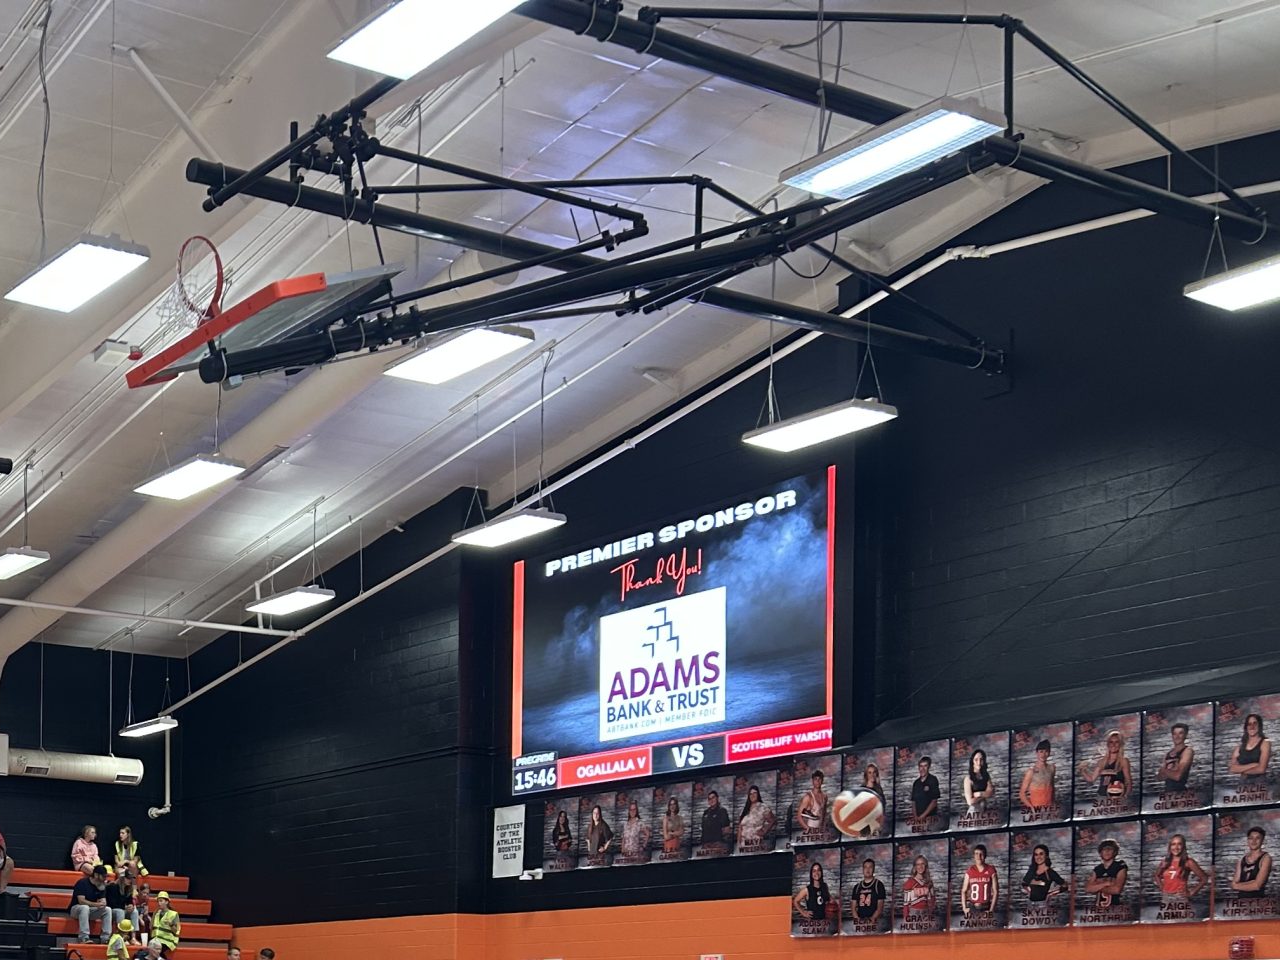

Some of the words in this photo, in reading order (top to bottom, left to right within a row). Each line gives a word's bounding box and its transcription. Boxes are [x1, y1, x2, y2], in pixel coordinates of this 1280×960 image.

[545, 532, 655, 577] PREMIER
[658, 490, 797, 544] SPONSOR
[610, 551, 665, 601] Thank
[666, 547, 702, 596] You!
[607, 650, 720, 703] ADAMS
[607, 700, 651, 723] BANK
[654, 700, 665, 713] &
[667, 686, 720, 711] TRUST
[731, 734, 793, 754] SCOTTSBLUFF
[794, 727, 833, 745] VARSITY
[575, 757, 636, 779] OGALLALA
[636, 756, 647, 769] V
[673, 743, 704, 768] VS
[514, 767, 557, 791] 15:46
[1154, 800, 1199, 811] GILMORE
[970, 884, 988, 900] 81
[1156, 910, 1195, 920] ARMIJO
[1160, 902, 1192, 911] PAIGE
[1022, 917, 1057, 926] DOWDY
